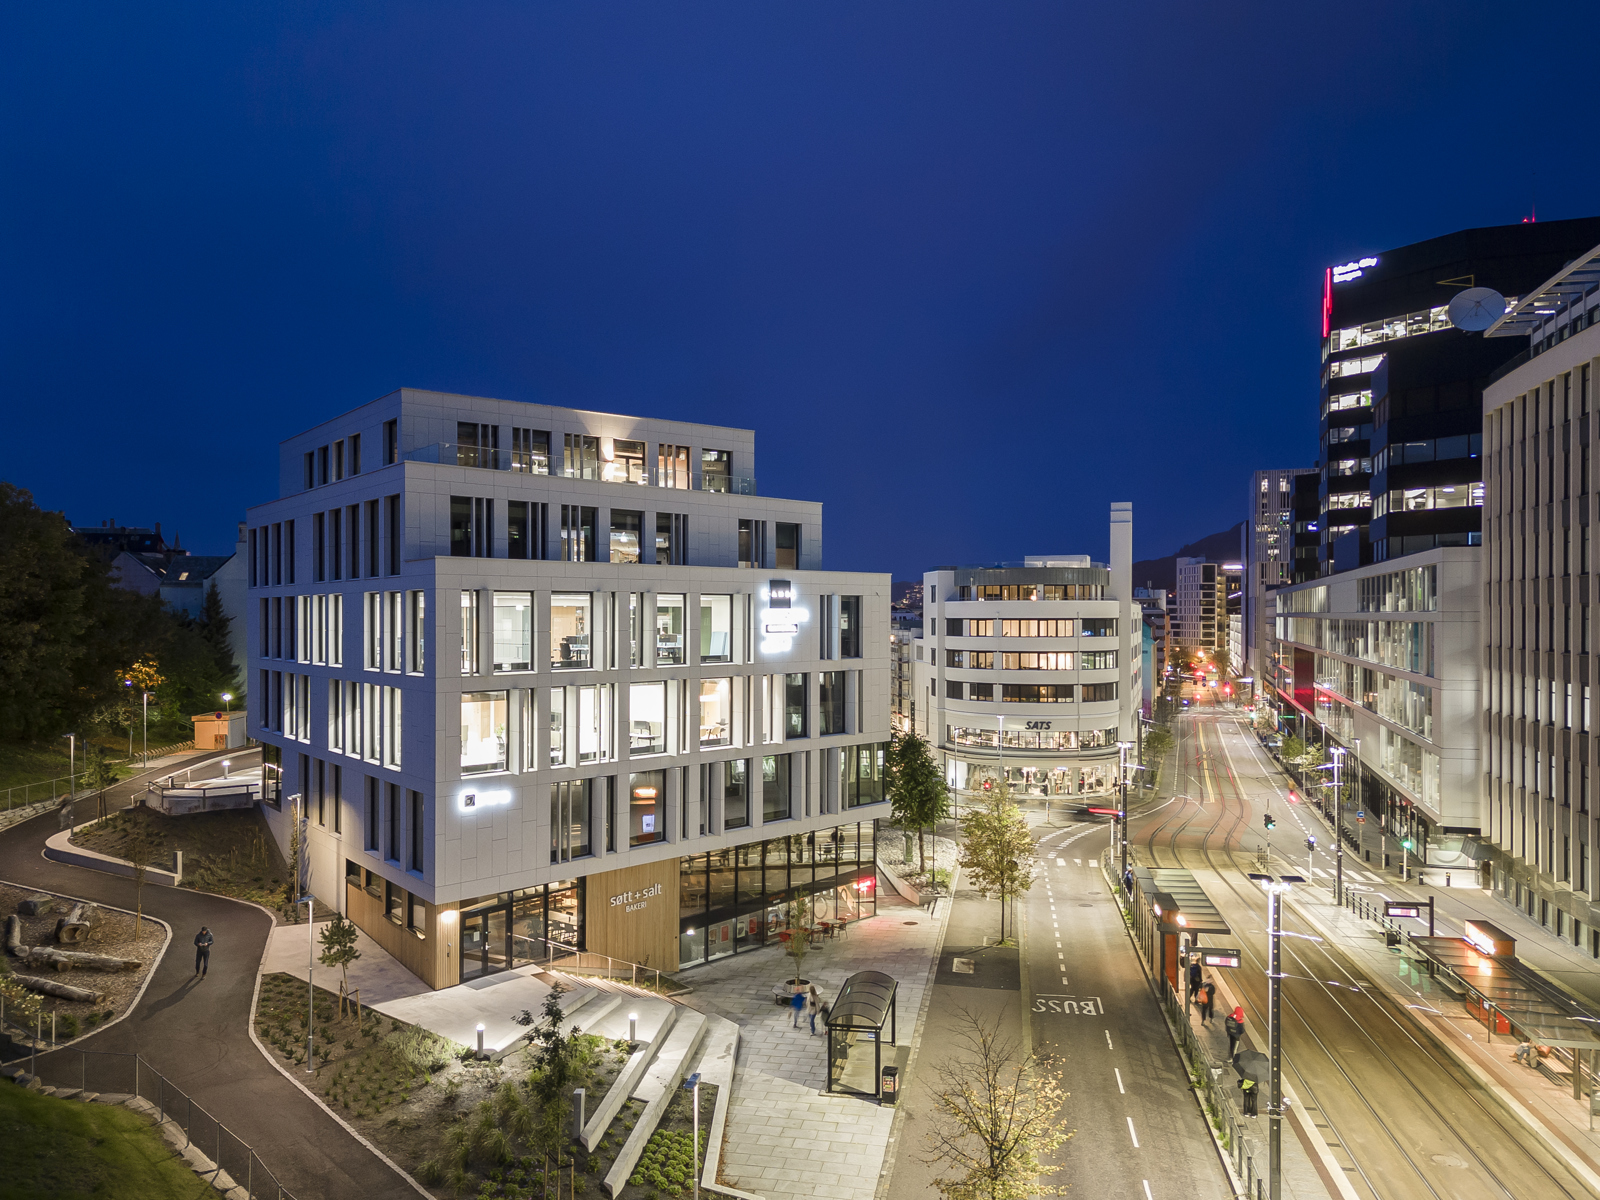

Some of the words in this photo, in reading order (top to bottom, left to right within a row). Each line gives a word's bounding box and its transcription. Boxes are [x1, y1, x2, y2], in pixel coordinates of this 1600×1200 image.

[1025, 721, 1052, 730] SATS
[610, 891, 633, 907] søtt
[634, 891, 641, 900] +
[642, 883, 662, 899] salt
[625, 901, 647, 913] BAKERI
[1031, 998, 1097, 1016] BUSS
